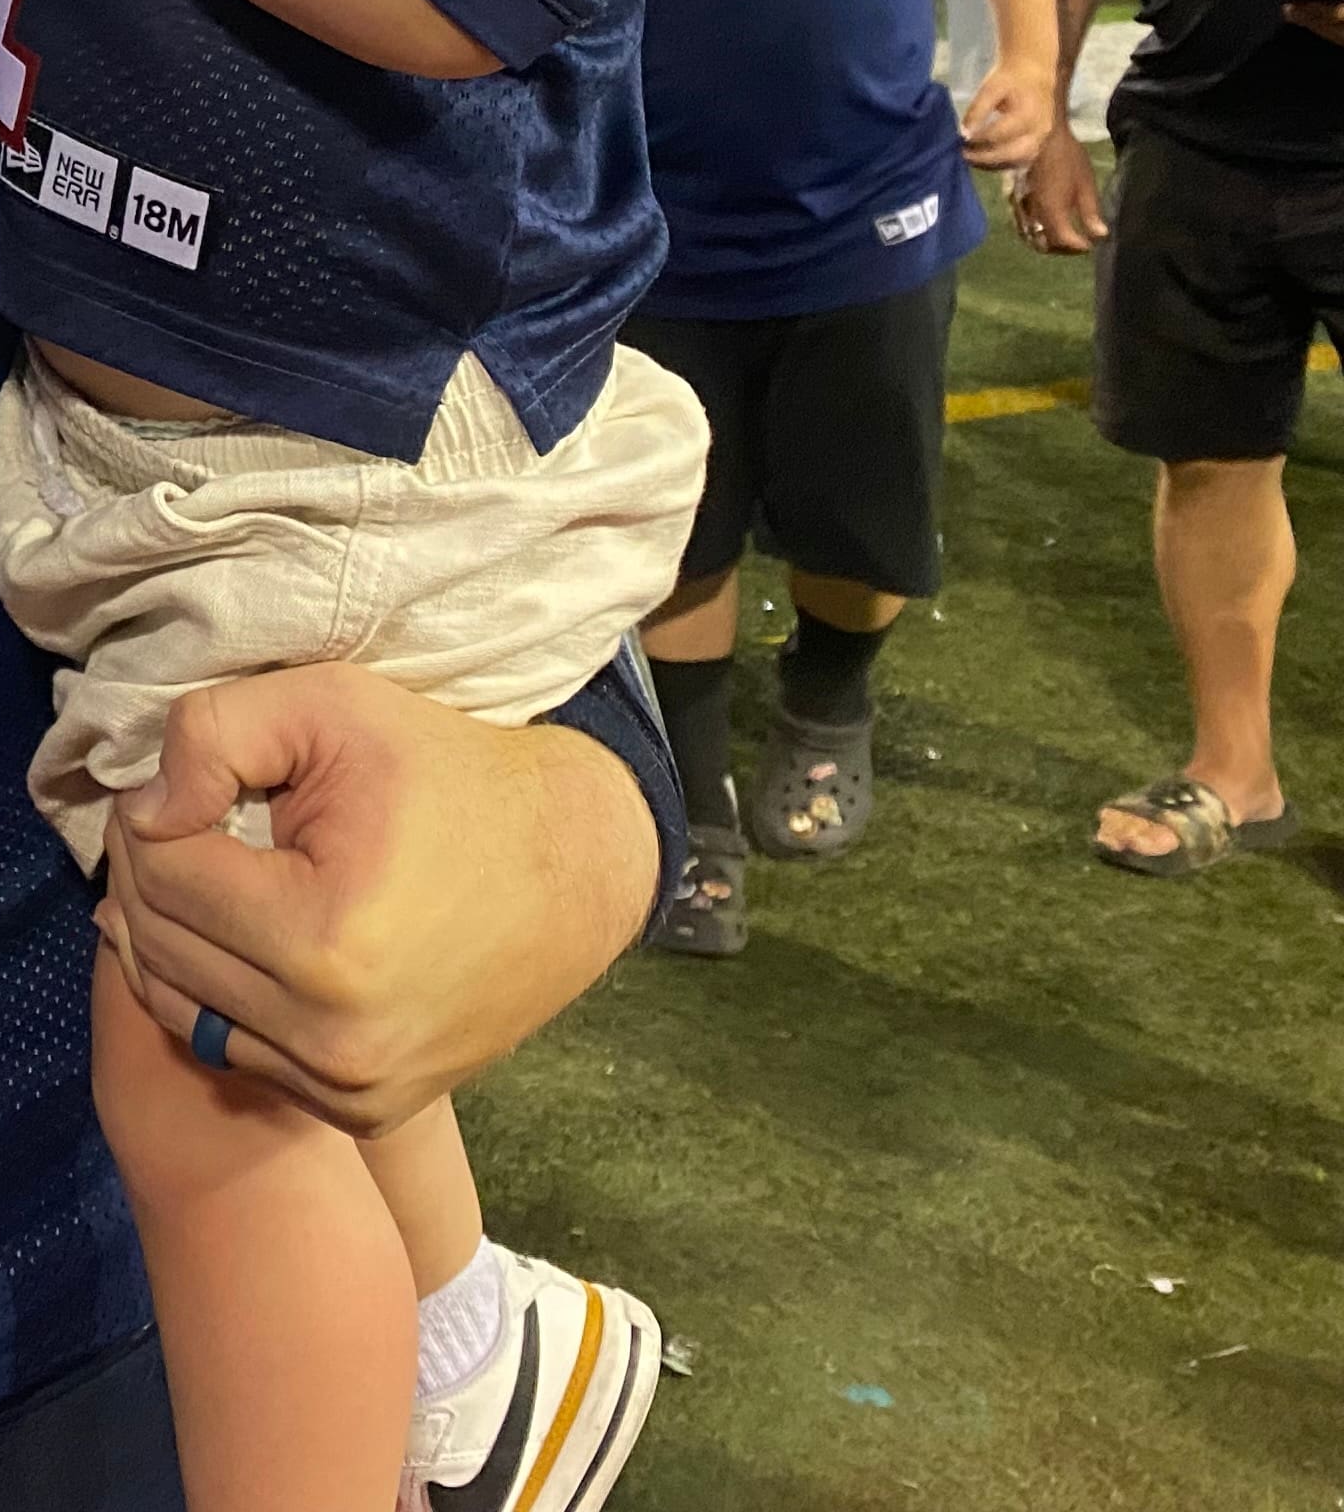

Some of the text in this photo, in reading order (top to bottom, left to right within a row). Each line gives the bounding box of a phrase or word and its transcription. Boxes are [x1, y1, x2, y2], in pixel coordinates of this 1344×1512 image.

[56, 151, 105, 192] NEW
[51, 174, 102, 214] ERA
[132, 193, 201, 247] 18M
